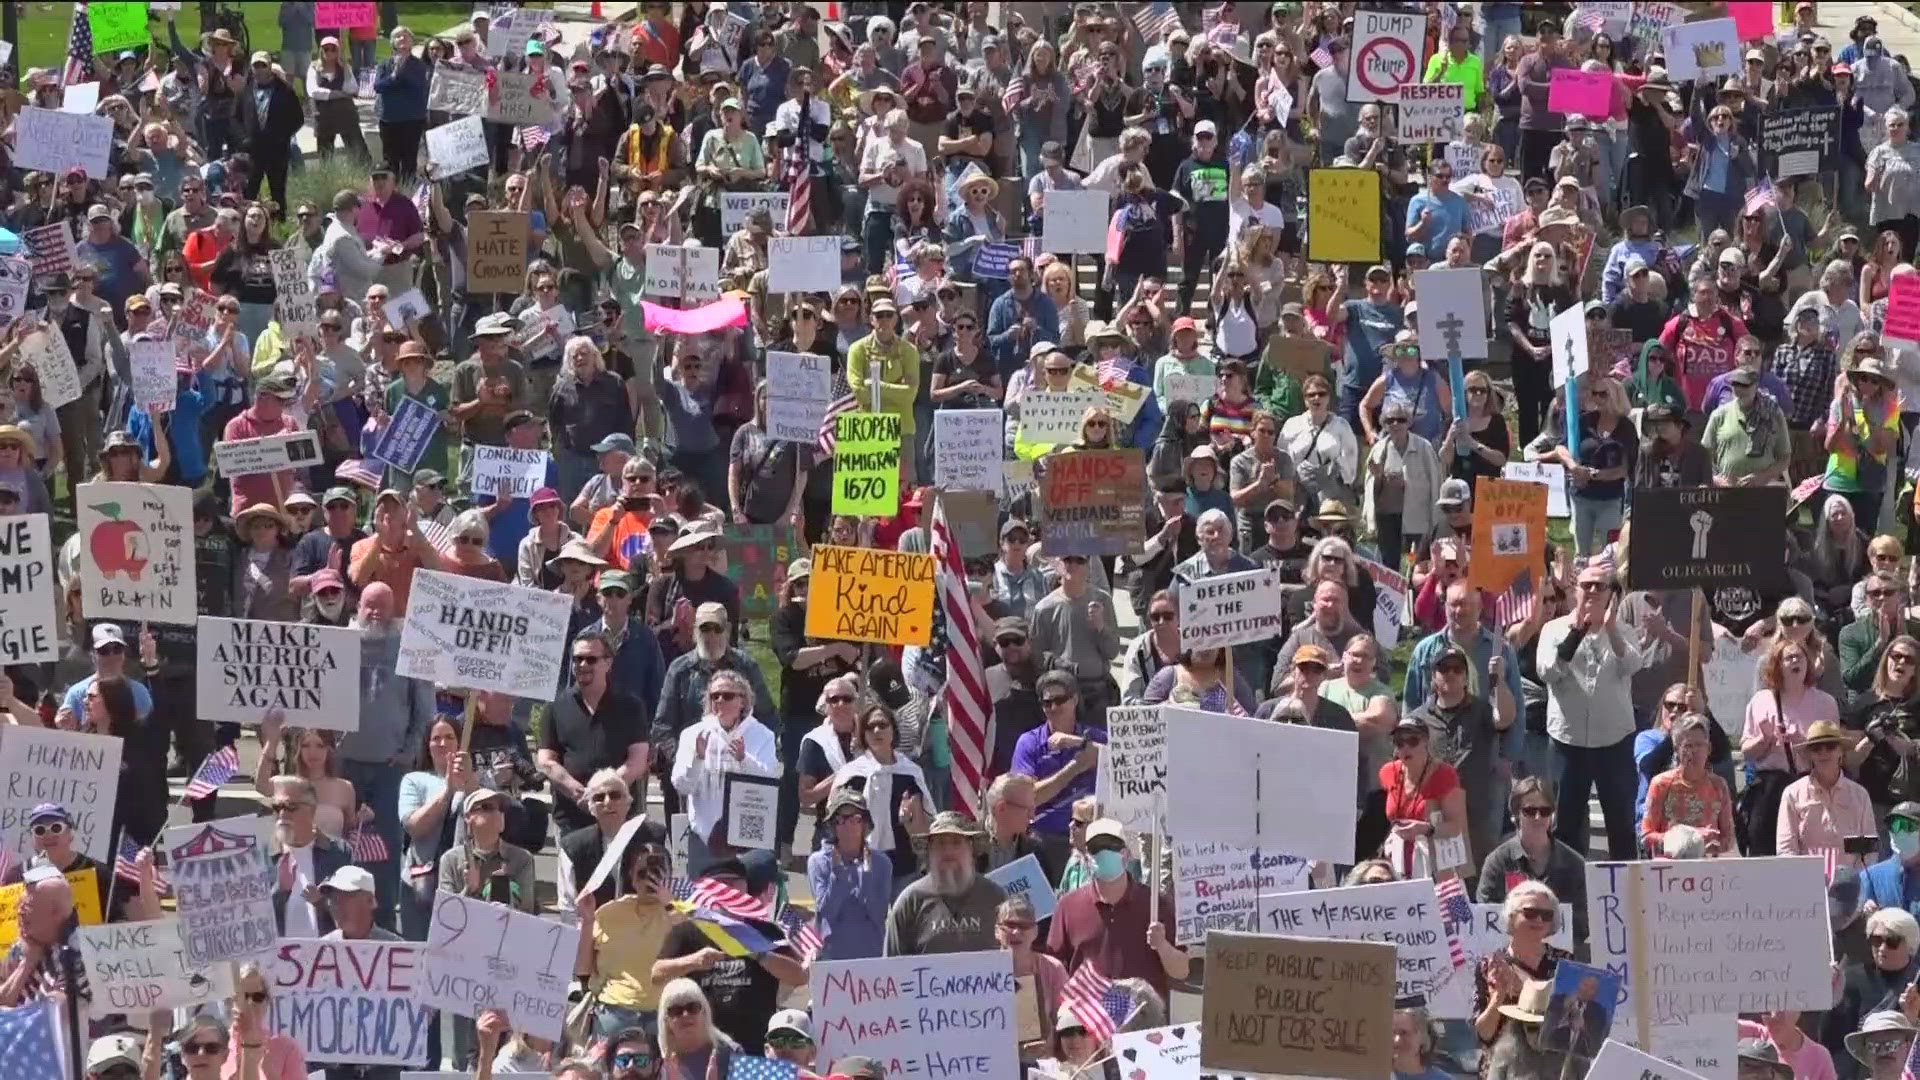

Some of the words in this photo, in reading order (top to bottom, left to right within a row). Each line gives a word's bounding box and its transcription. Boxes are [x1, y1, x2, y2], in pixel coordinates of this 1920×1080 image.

[1366, 14, 1413, 34] DUMP
[1367, 57, 1406, 75] TRUMP
[1400, 85, 1463, 100] RESPECT
[726, 197, 748, 209] WE
[490, 220, 507, 235] I
[476, 239, 520, 256] HATE
[1037, 421, 1078, 432] PUPPE
[477, 447, 541, 464] CONGRESS
[498, 464, 512, 474] IS
[1052, 456, 1127, 480] HANDS
[844, 477, 886, 500] 1670
[1049, 482, 1092, 506] OFF
[1679, 491, 1721, 505] FIGHT
[812, 548, 857, 573] MAKE
[860, 553, 935, 583] AMERICA
[1661, 562, 1753, 579] OLIGARCHY
[101, 587, 173, 609] BRAIN
[836, 576, 916, 616] Kind
[1197, 579, 1256, 600] DEFEND
[438, 604, 529, 636] HANDS
[1215, 600, 1243, 616] THE
[231, 622, 321, 648] MAKE
[837, 613, 899, 638] AGAIN
[1183, 614, 1281, 640] CONSTITUTION
[455, 628, 512, 656] OFF!!
[213, 643, 337, 669] AMERICA
[224, 665, 326, 688] SMART
[229, 687, 321, 710] AGAIN
[28, 744, 104, 771] HUMAN
[8, 771, 97, 804] RIGHTS
[1119, 780, 1167, 799] TRUM
[2, 807, 96, 835] BENG
[1651, 865, 1744, 904] Tragic
[1268, 907, 1304, 930] THE
[1312, 900, 1396, 930] MEASURE
[1407, 903, 1428, 918] OF
[86, 925, 156, 951] WAKE
[1384, 930, 1437, 946] FOUND
[1653, 934, 1713, 954] United
[95, 957, 164, 982] SMELL
[276, 944, 415, 992] SAVE
[1266, 956, 1325, 981] PUBLIC
[1397, 956, 1437, 972] REAT
[1654, 961, 1738, 985] Morals
[109, 984, 163, 1009] COUP
[1255, 986, 1326, 1014] PUBLIC
[919, 1006, 1005, 1035] RACISM
[1228, 1012, 1273, 1044] NOT
[1279, 1017, 1315, 1048] FOR
[1321, 1017, 1369, 1052] SALE
[925, 1051, 992, 1078] HATE
